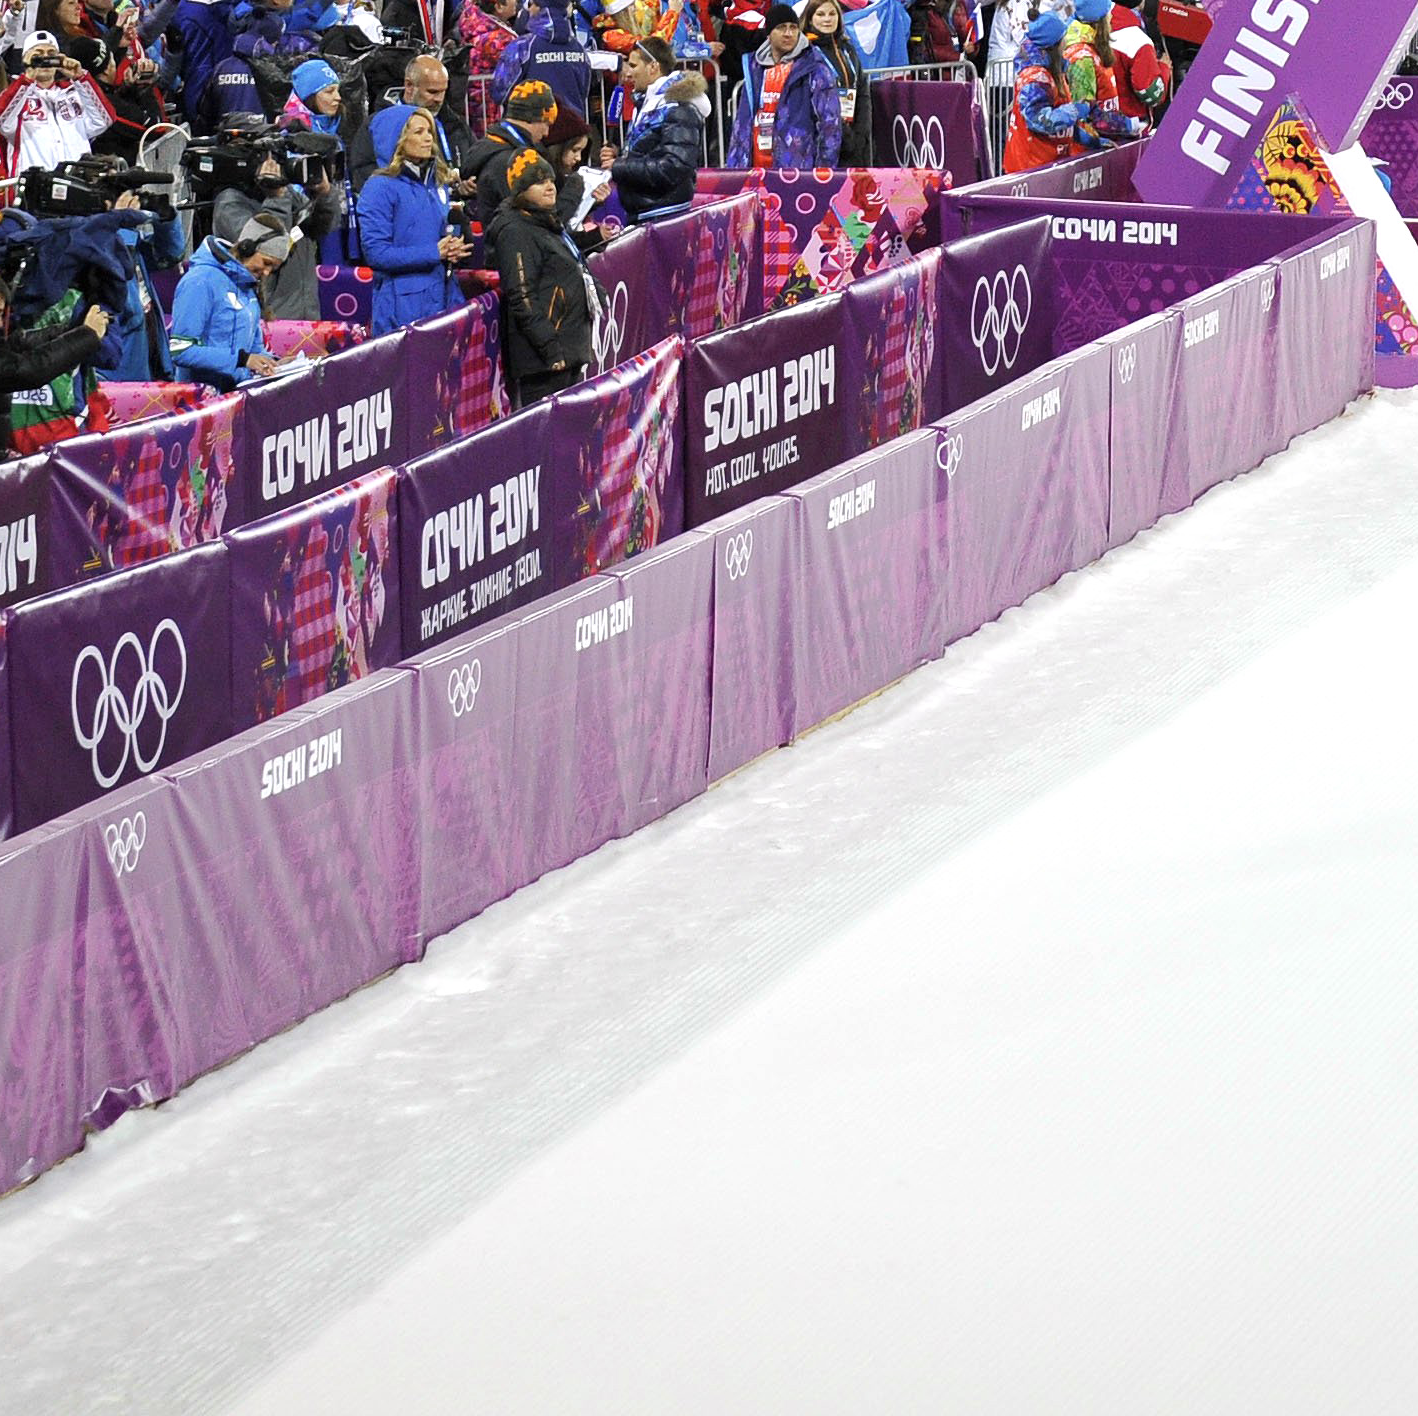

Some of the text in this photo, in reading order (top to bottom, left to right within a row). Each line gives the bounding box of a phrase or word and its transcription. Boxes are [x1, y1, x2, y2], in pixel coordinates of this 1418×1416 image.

[218, 73, 249, 85] SOCHI
[535, 52, 564, 64] SOCHI
[1052, 217, 1178, 246] СОЧИ 2014
[1184, 309, 1220, 348] SOCHI 2014
[704, 345, 835, 453] SOCHI 2014
[1021, 387, 1061, 432] СОЧИ 2014
[262, 388, 393, 501] СОЧИ 2014
[704, 434, 799, 498] HOT. COOL. YOURS.
[421, 465, 541, 590] СОЧИ 2014
[827, 480, 876, 531] SOCHI 2014
[513, 548, 542, 594] ТВОИ.
[575, 596, 633, 652] СОЧИ 2014
[260, 728, 342, 799] SOCHI 2014
